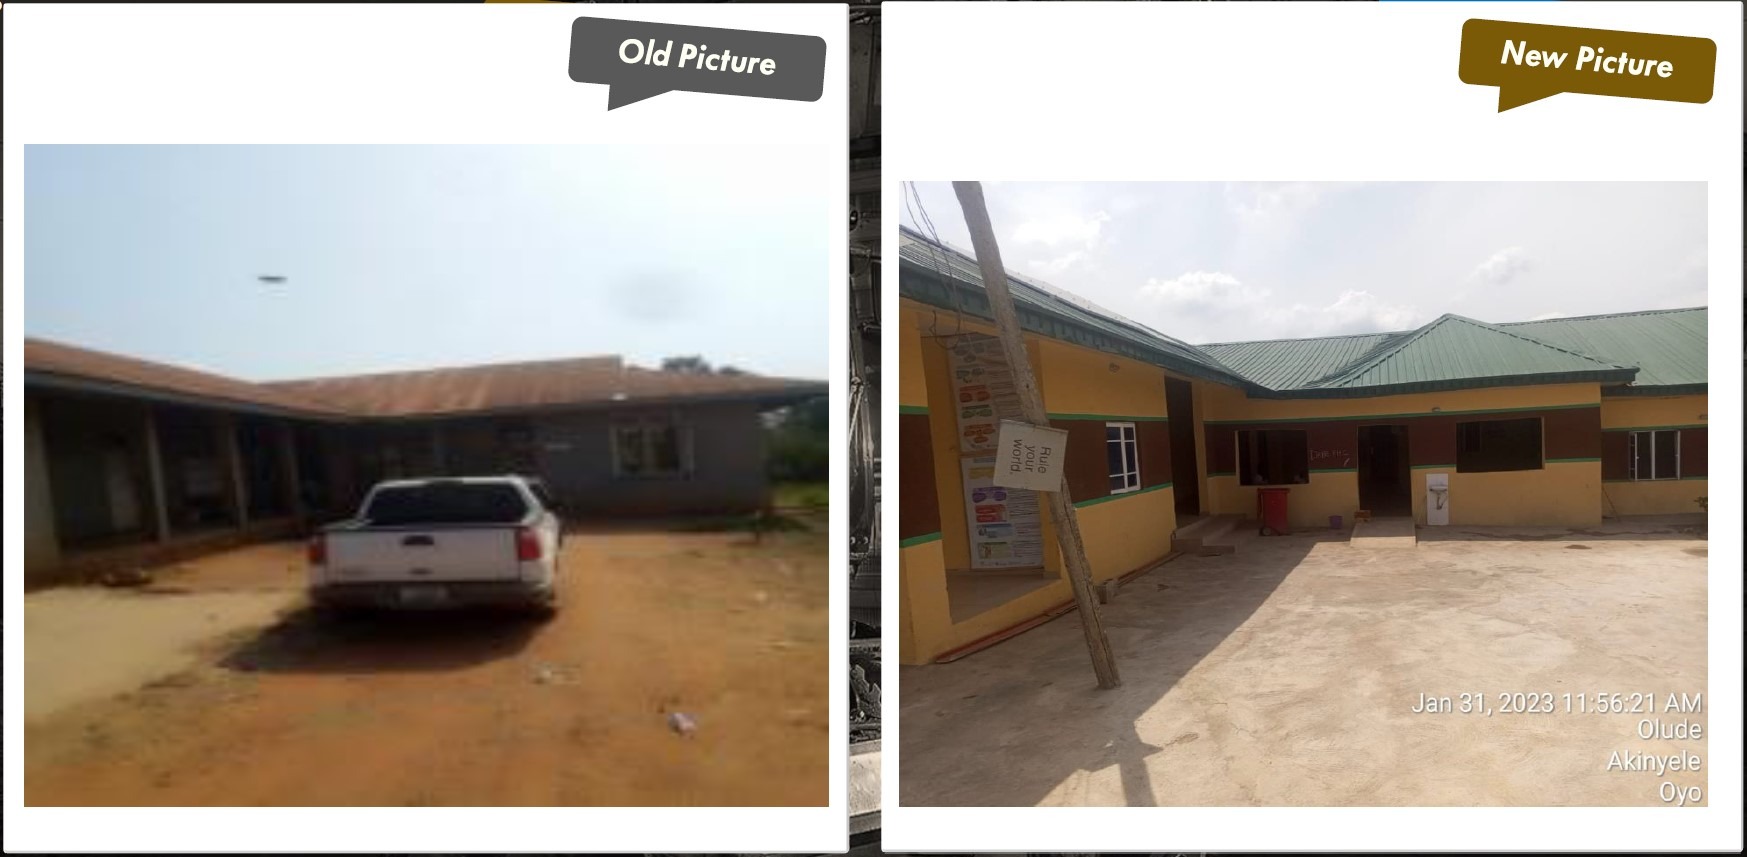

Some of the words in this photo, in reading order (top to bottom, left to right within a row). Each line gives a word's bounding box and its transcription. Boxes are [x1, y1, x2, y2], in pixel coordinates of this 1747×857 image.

[1009, 439, 1023, 475] world.
[1024, 444, 1035, 473] your
[1037, 446, 1052, 474] Rule
